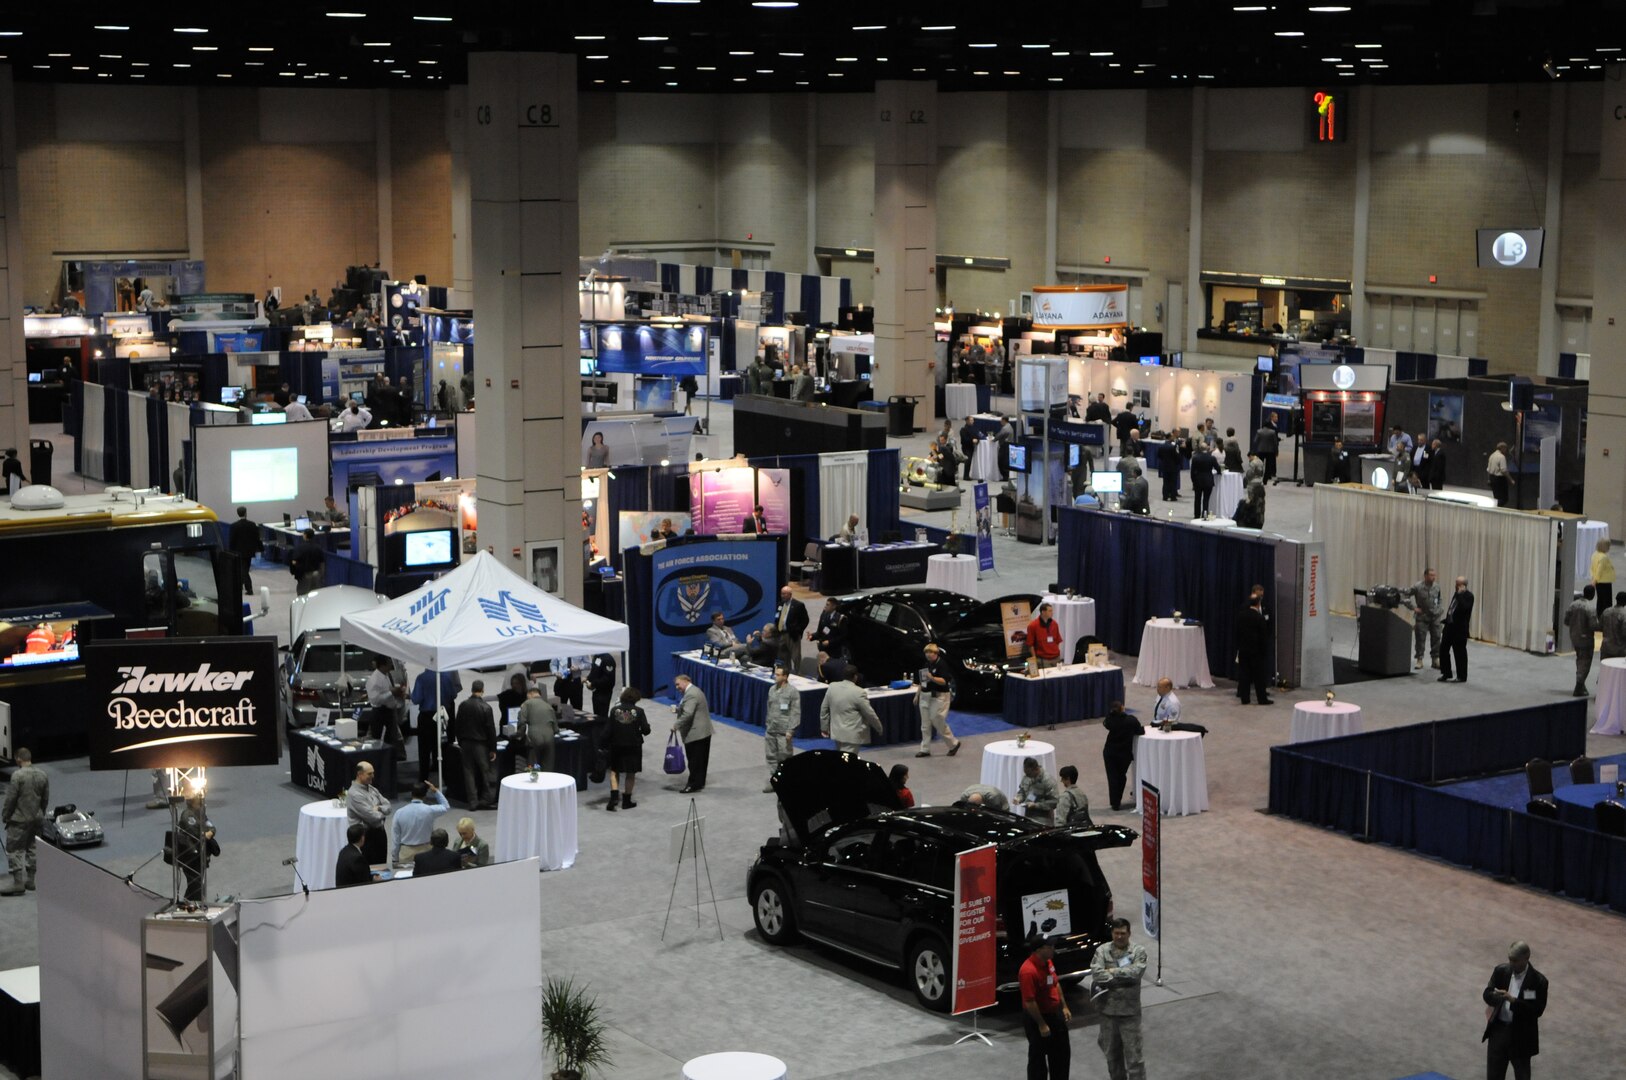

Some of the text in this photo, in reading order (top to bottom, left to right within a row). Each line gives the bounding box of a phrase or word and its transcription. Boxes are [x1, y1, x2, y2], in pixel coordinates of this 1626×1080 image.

[477, 105, 491, 125] C8
[527, 104, 552, 124] C8
[910, 110, 925, 122] C2
[1497, 235, 1524, 262] L3
[1092, 311, 1123, 320] ADAYANA
[340, 448, 376, 457] Leadership
[378, 445, 419, 453] Development
[675, 556, 694, 566] FORCE
[696, 553, 749, 562] ASSOCIATION
[1309, 555, 1318, 617] Honeywell
[381, 617, 420, 635] USAA
[495, 624, 557, 638] USAA
[111, 663, 254, 694] Hawker
[107, 697, 257, 730] Beechcraft
[307, 773, 325, 792] USAA
[968, 898, 983, 907] SURE
[959, 906, 986, 918] REGISTER
[959, 915, 985, 927] FOR OUR
[959, 927, 976, 935] PRIZE
[959, 931, 991, 945] GIVEAWAYS
